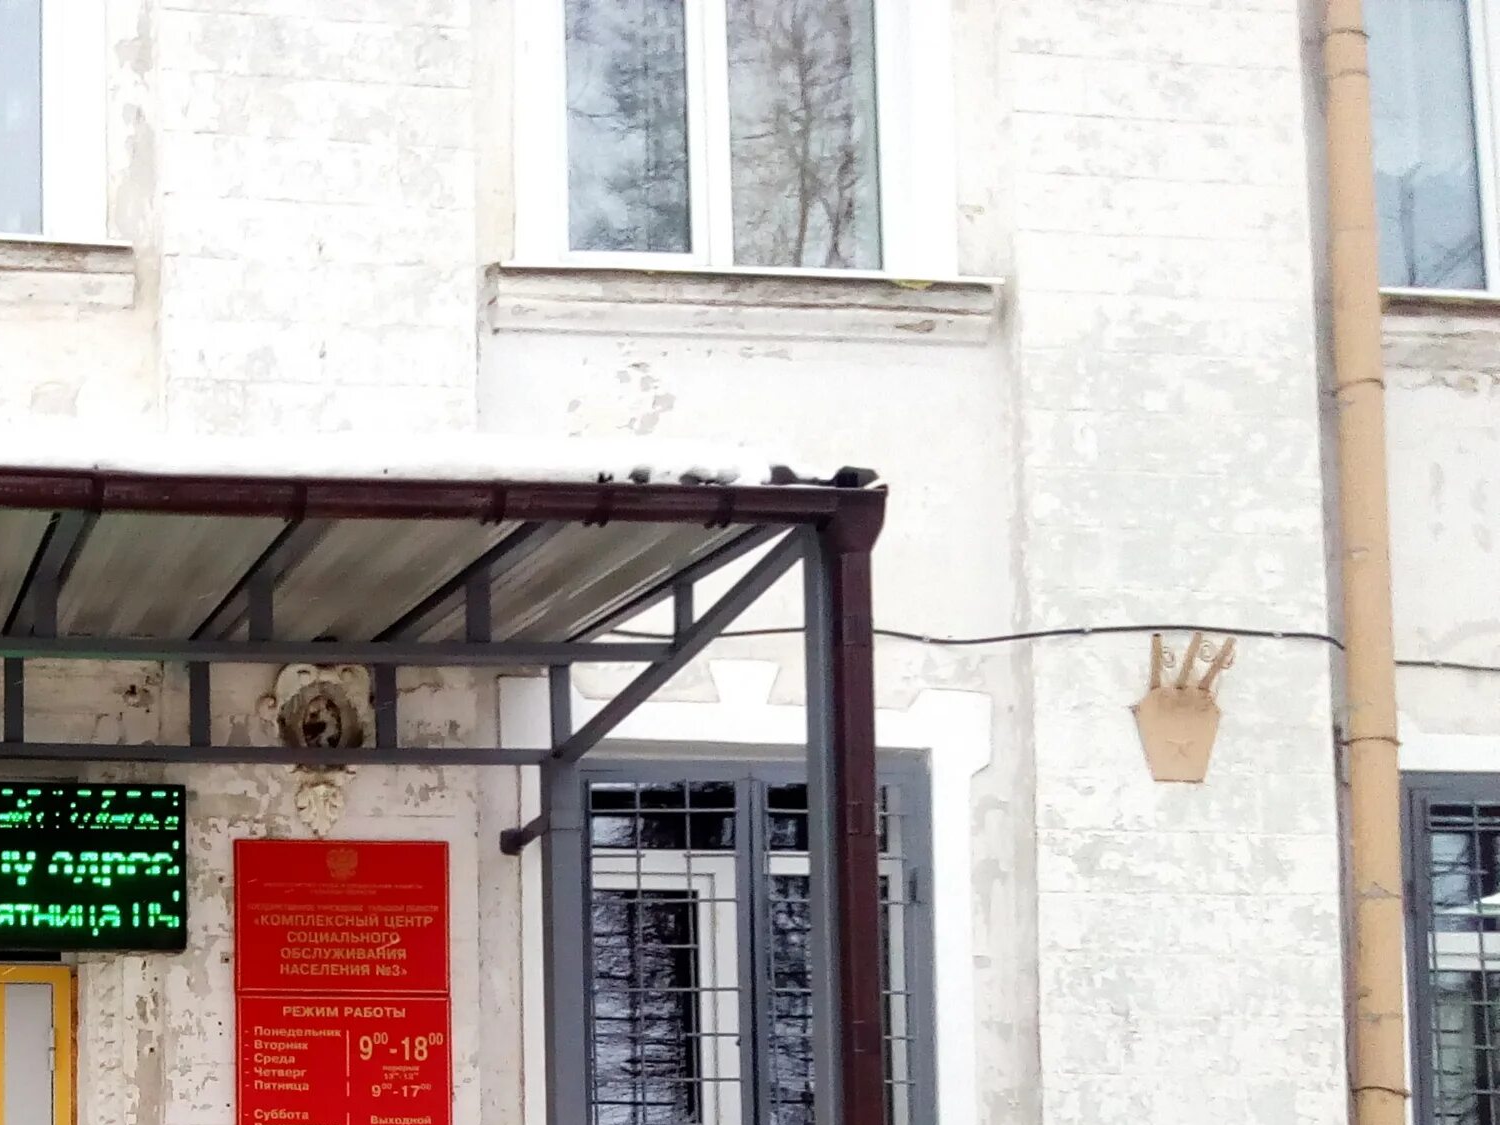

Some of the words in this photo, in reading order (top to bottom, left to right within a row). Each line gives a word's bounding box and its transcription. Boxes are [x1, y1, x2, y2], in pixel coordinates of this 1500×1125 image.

[384, 915, 434, 929] ЦЕНТР
[287, 931, 400, 945] СОЦИАЛЬНОГО
[280, 947, 407, 960] ОБСЛУЖИВАНИЯ
[280, 963, 370, 976] НАСЕЛЕНИЯ
[283, 1006, 339, 1018] РЕЖИМ
[344, 1006, 406, 1019] РАБОТЫ
[254, 1026, 341, 1037] Понедельник
[254, 1040, 308, 1051] Вторник
[254, 1054, 295, 1065] Среда
[254, 1067, 307, 1078] Четверг
[254, 1081, 309, 1092] Пятница
[254, 1109, 309, 1120] Суббота
[370, 1114, 431, 1125] Выходной
